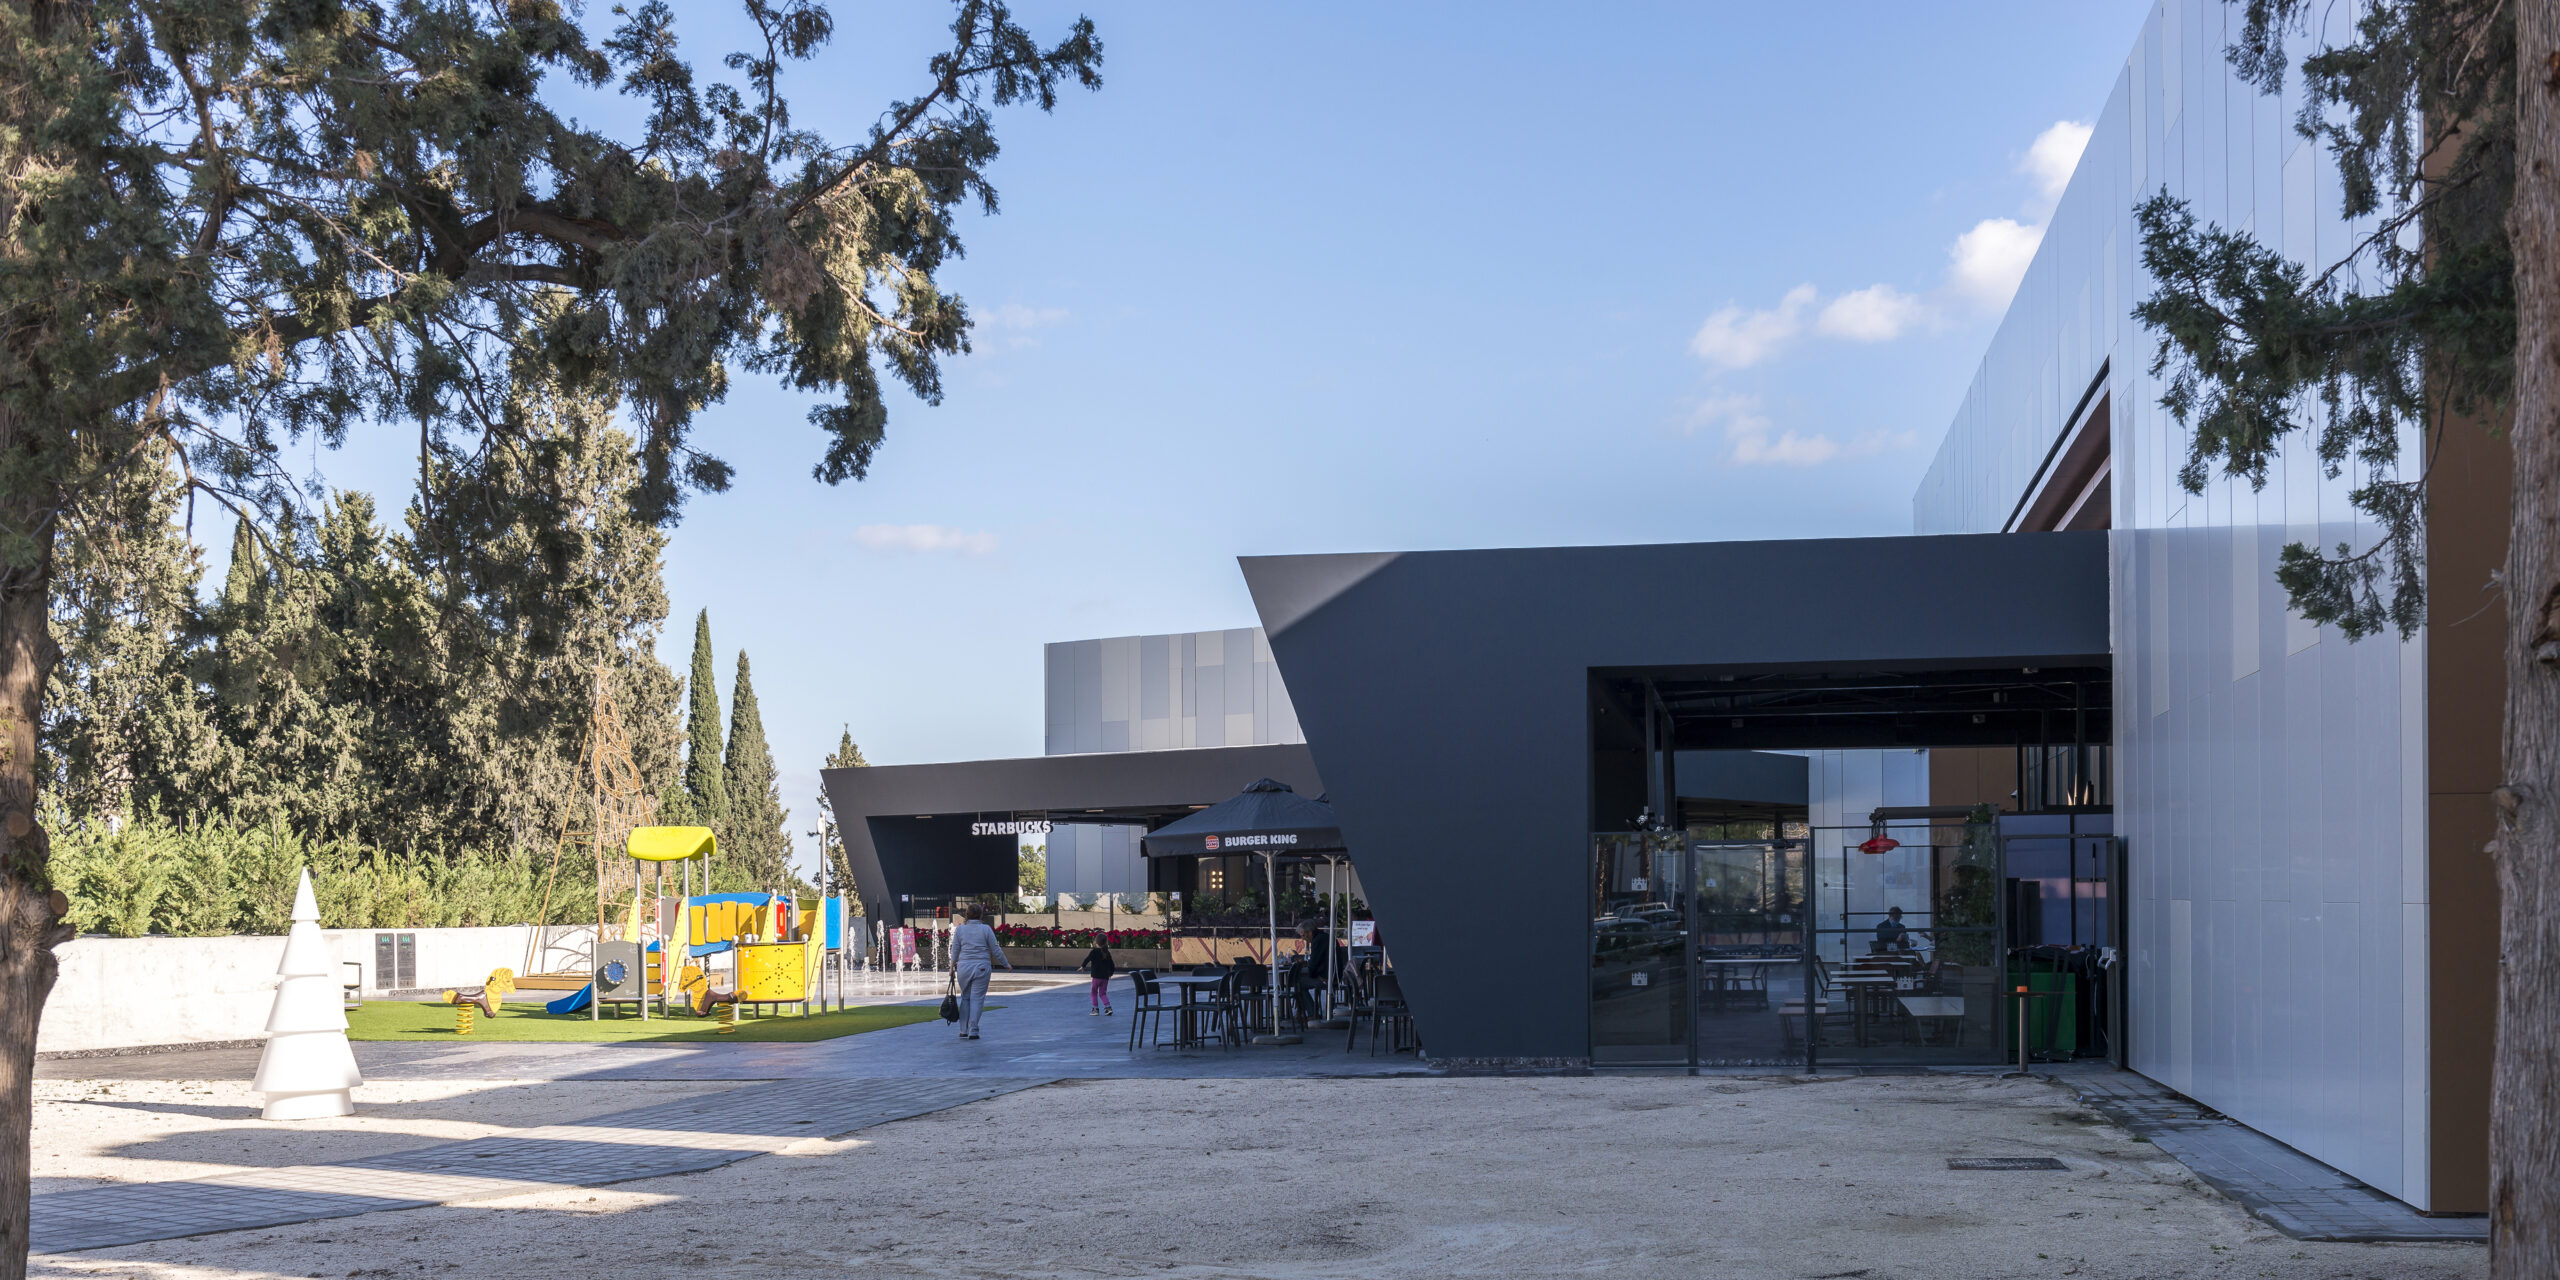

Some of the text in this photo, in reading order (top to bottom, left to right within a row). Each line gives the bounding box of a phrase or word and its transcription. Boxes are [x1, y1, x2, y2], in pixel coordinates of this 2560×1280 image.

[971, 820, 1052, 836] STARBUCKS
[1224, 834, 1268, 847] BURGER
[1270, 834, 1298, 845] KING
